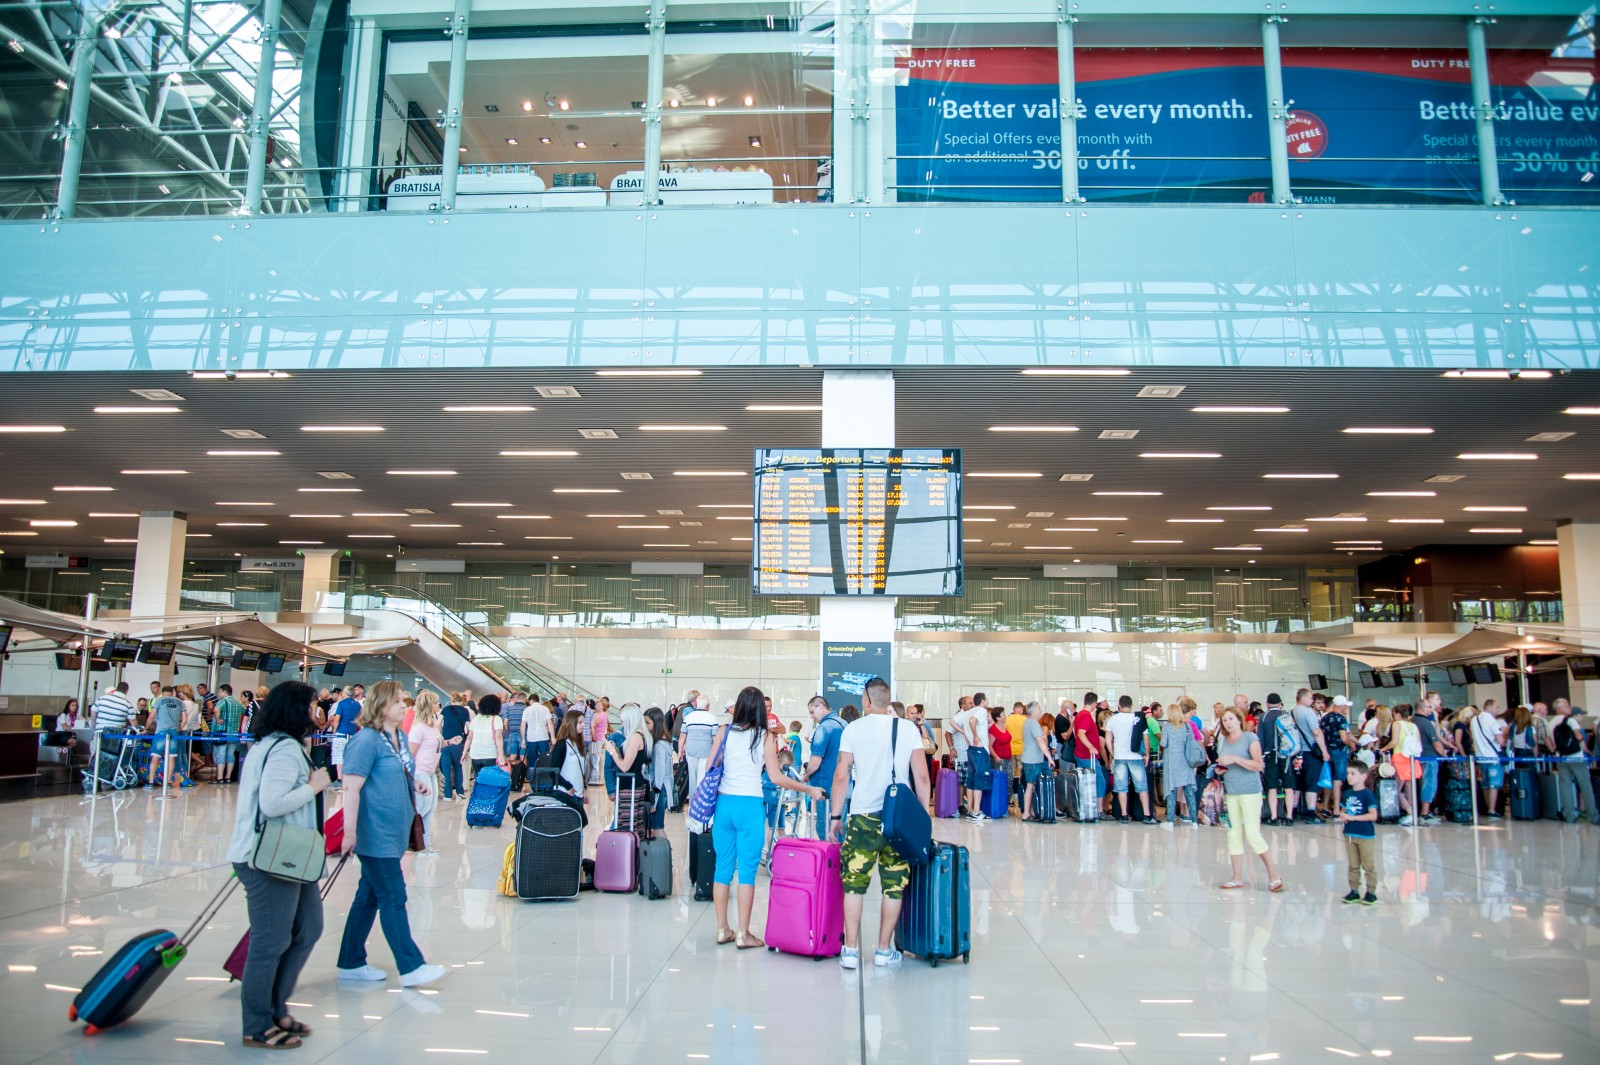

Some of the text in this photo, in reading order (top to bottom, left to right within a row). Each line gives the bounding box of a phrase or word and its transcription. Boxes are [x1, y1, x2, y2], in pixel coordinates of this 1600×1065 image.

[908, 60, 976, 68] DUTY FREE
[1412, 60, 1471, 68] DUTY FRE
[943, 98, 1253, 124] Better vale every month.
[1419, 100, 1600, 122] Bette value ev
[944, 132, 1152, 147] Special Offers eve month with
[1286, 128, 1322, 144] UTY FREE
[1423, 134, 1598, 149] Special Oers every month
[944, 152, 958, 162] an
[964, 150, 1028, 162] additional
[1096, 149, 1136, 170] off.
[1512, 152, 1568, 173] 30%
[394, 183, 442, 192] BRATISLA
[616, 178, 678, 188] BRATAVA
[782, 456, 809, 464] Odlety
[816, 456, 862, 464] Departures
